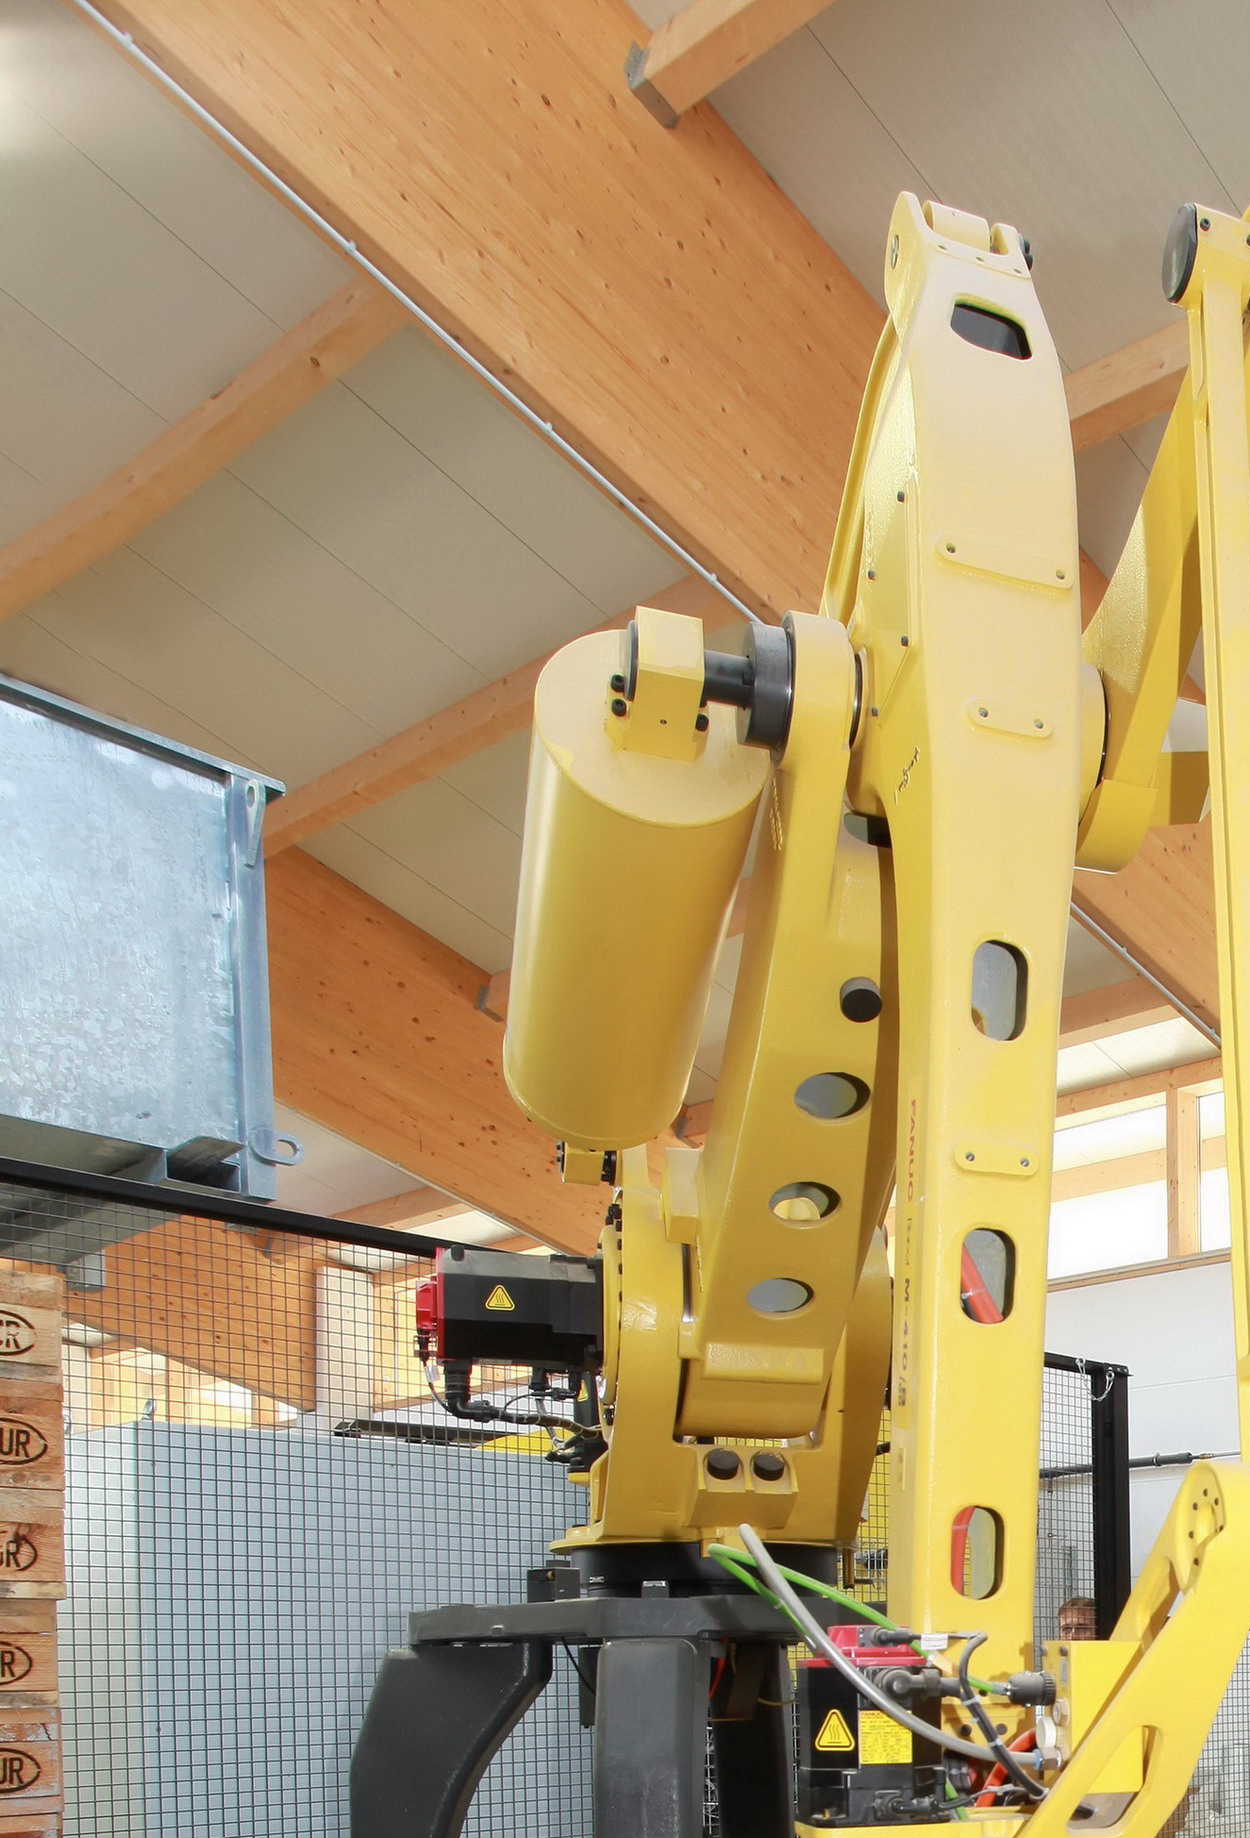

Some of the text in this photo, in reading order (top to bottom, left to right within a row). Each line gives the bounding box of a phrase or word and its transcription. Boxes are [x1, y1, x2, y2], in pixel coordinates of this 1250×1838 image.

[908, 1099, 916, 1202] FANUC
[0, 1429, 31, 1459] UR
[0, 1757, 24, 1785] UR
